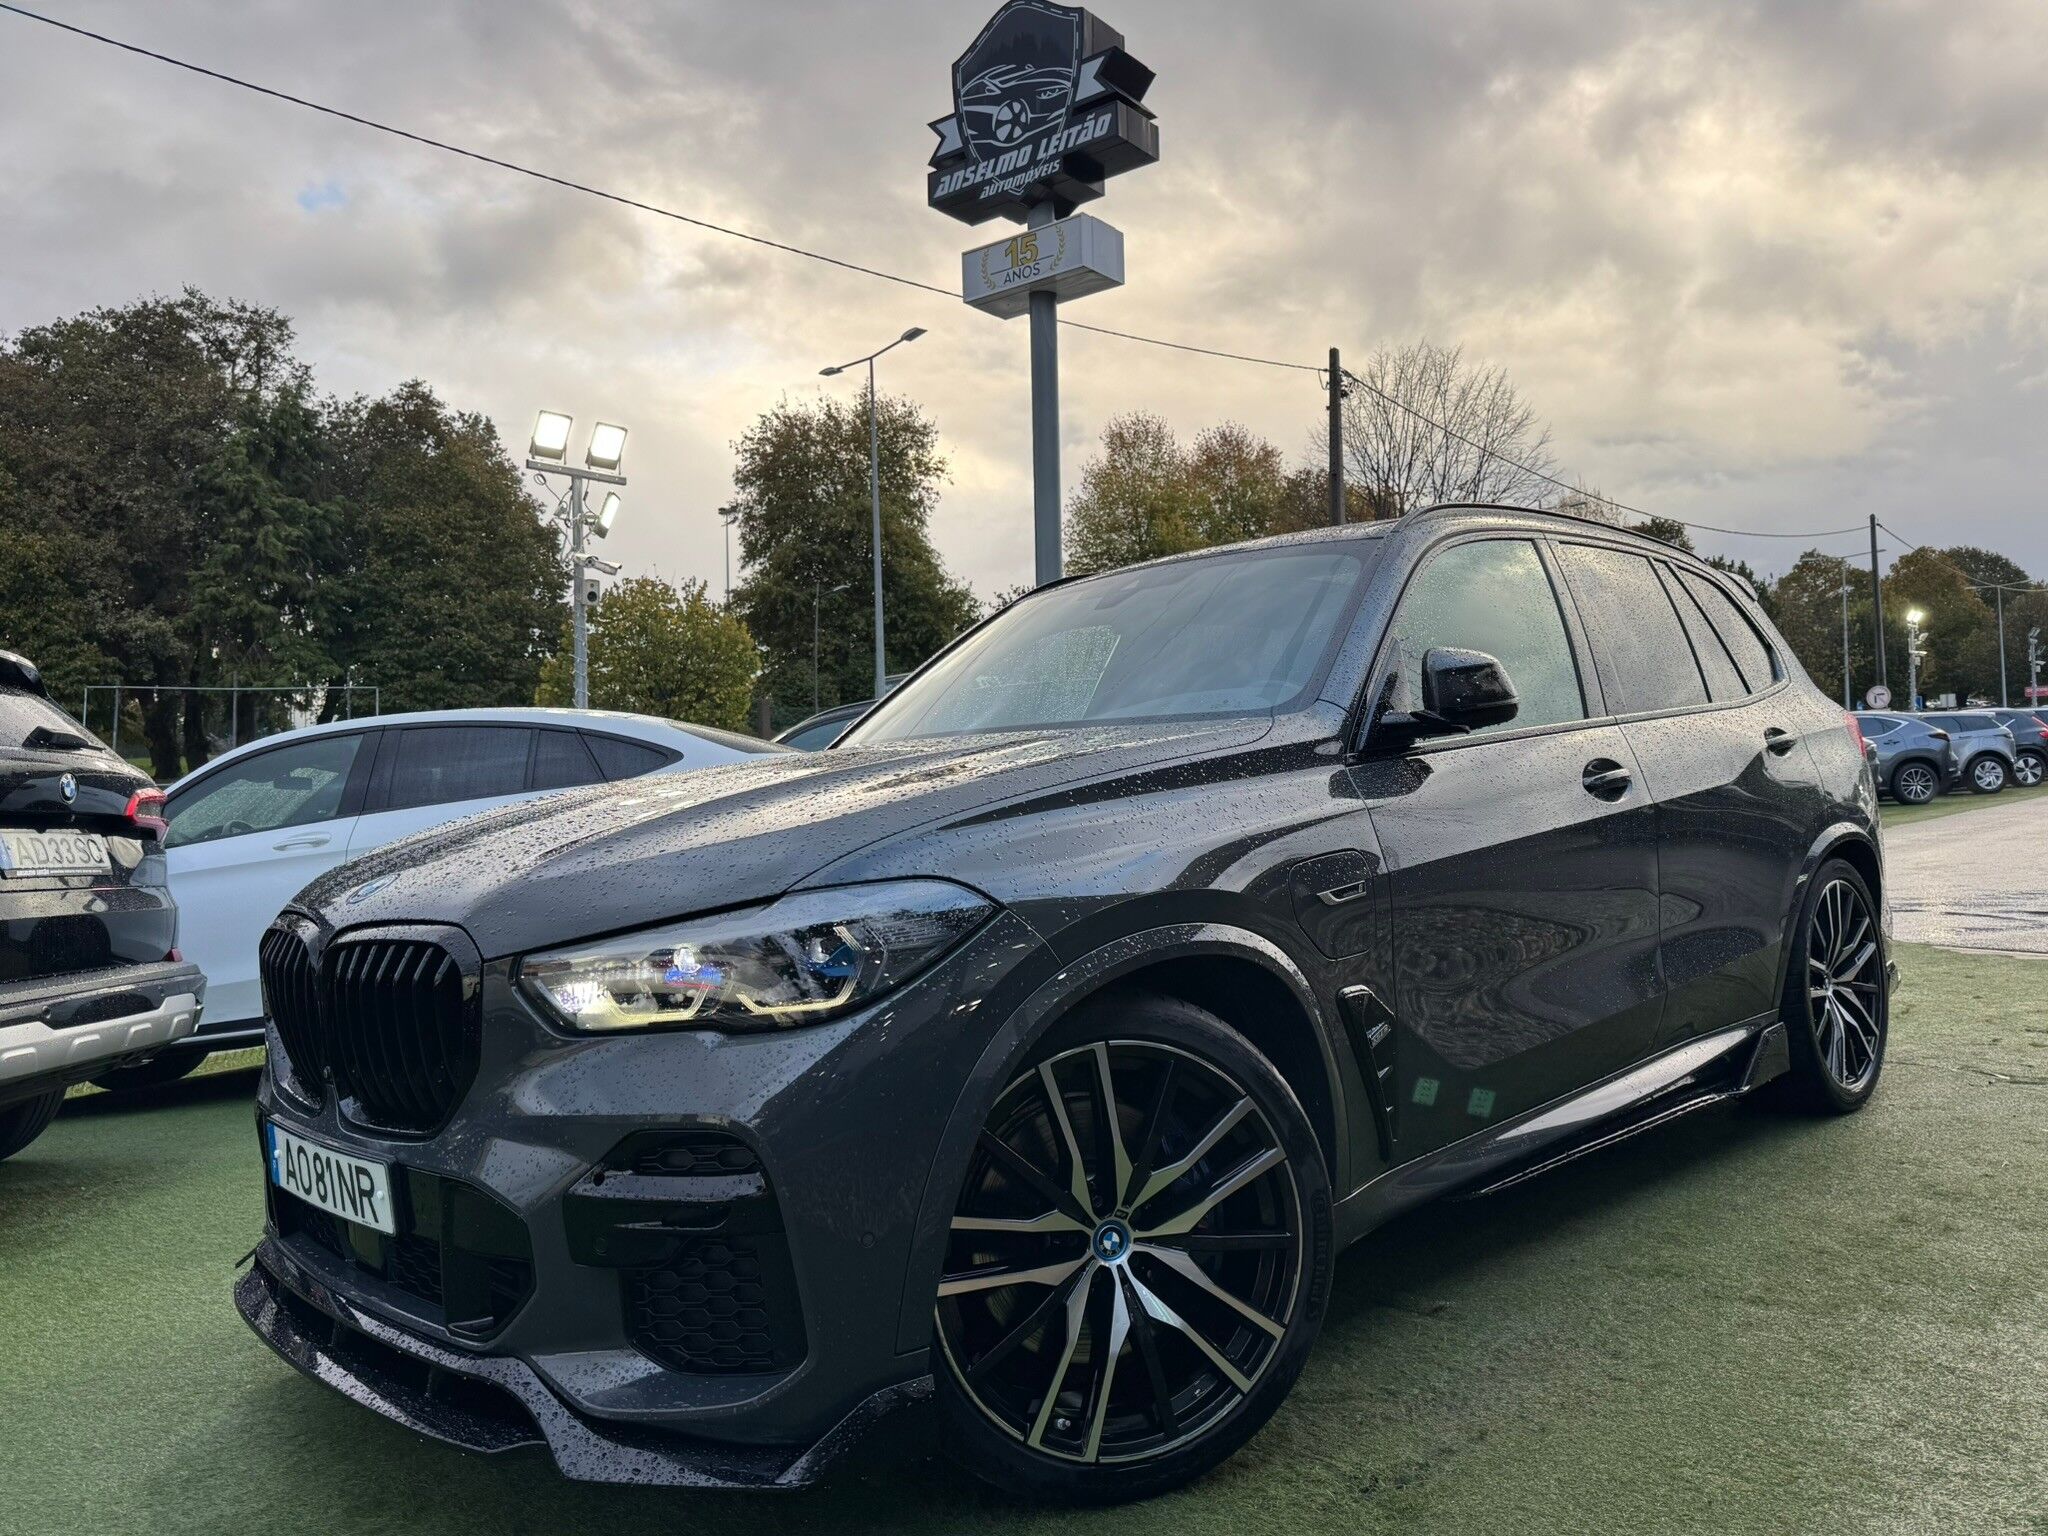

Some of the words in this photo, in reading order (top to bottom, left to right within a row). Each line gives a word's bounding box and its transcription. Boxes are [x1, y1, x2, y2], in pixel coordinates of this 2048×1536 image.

[1005, 233, 1038, 268] 15
[1003, 262, 1041, 285] ANOS
[286, 1138, 379, 1224] AO81NR
